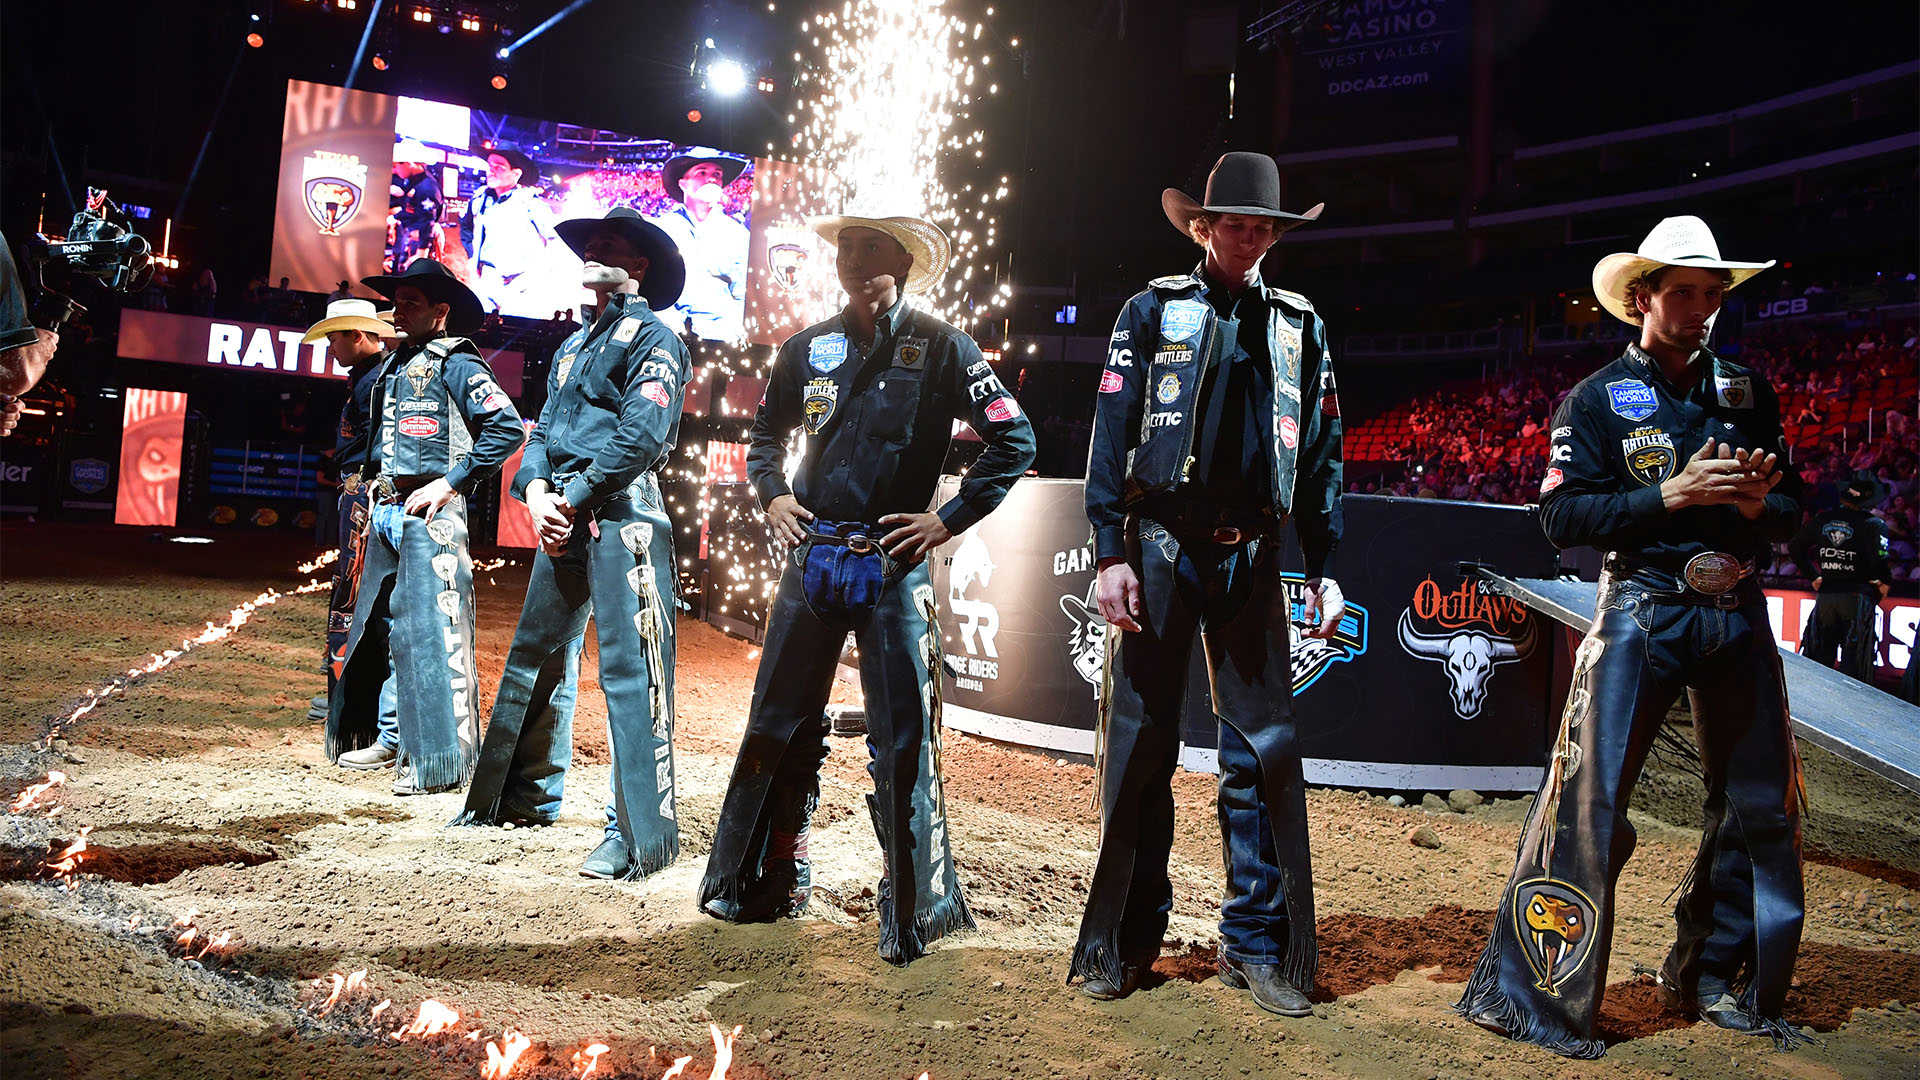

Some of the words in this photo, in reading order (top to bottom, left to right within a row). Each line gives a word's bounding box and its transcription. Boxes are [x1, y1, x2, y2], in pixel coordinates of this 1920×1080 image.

[1319, 53, 1367, 71] WEST
[1375, 41, 1441, 63] VALLEY
[1328, 72, 1429, 95] DDCAZ.com
[62, 244, 93, 254] RONIN
[1759, 298, 1808, 318] JCB
[1162, 344, 1187, 352] TEXAS
[1154, 350, 1193, 365] RATTLERS
[1613, 388, 1650, 397] CAMPING
[1615, 394, 1652, 403] WORLD
[382, 392, 397, 459] ARIAT
[402, 423, 437, 432] Community
[1628, 429, 1663, 438] TEXAS
[1622, 433, 1674, 457] RATTLERS
[968, 658, 999, 680] RIDERS
[443, 626, 472, 746] ARIAT
